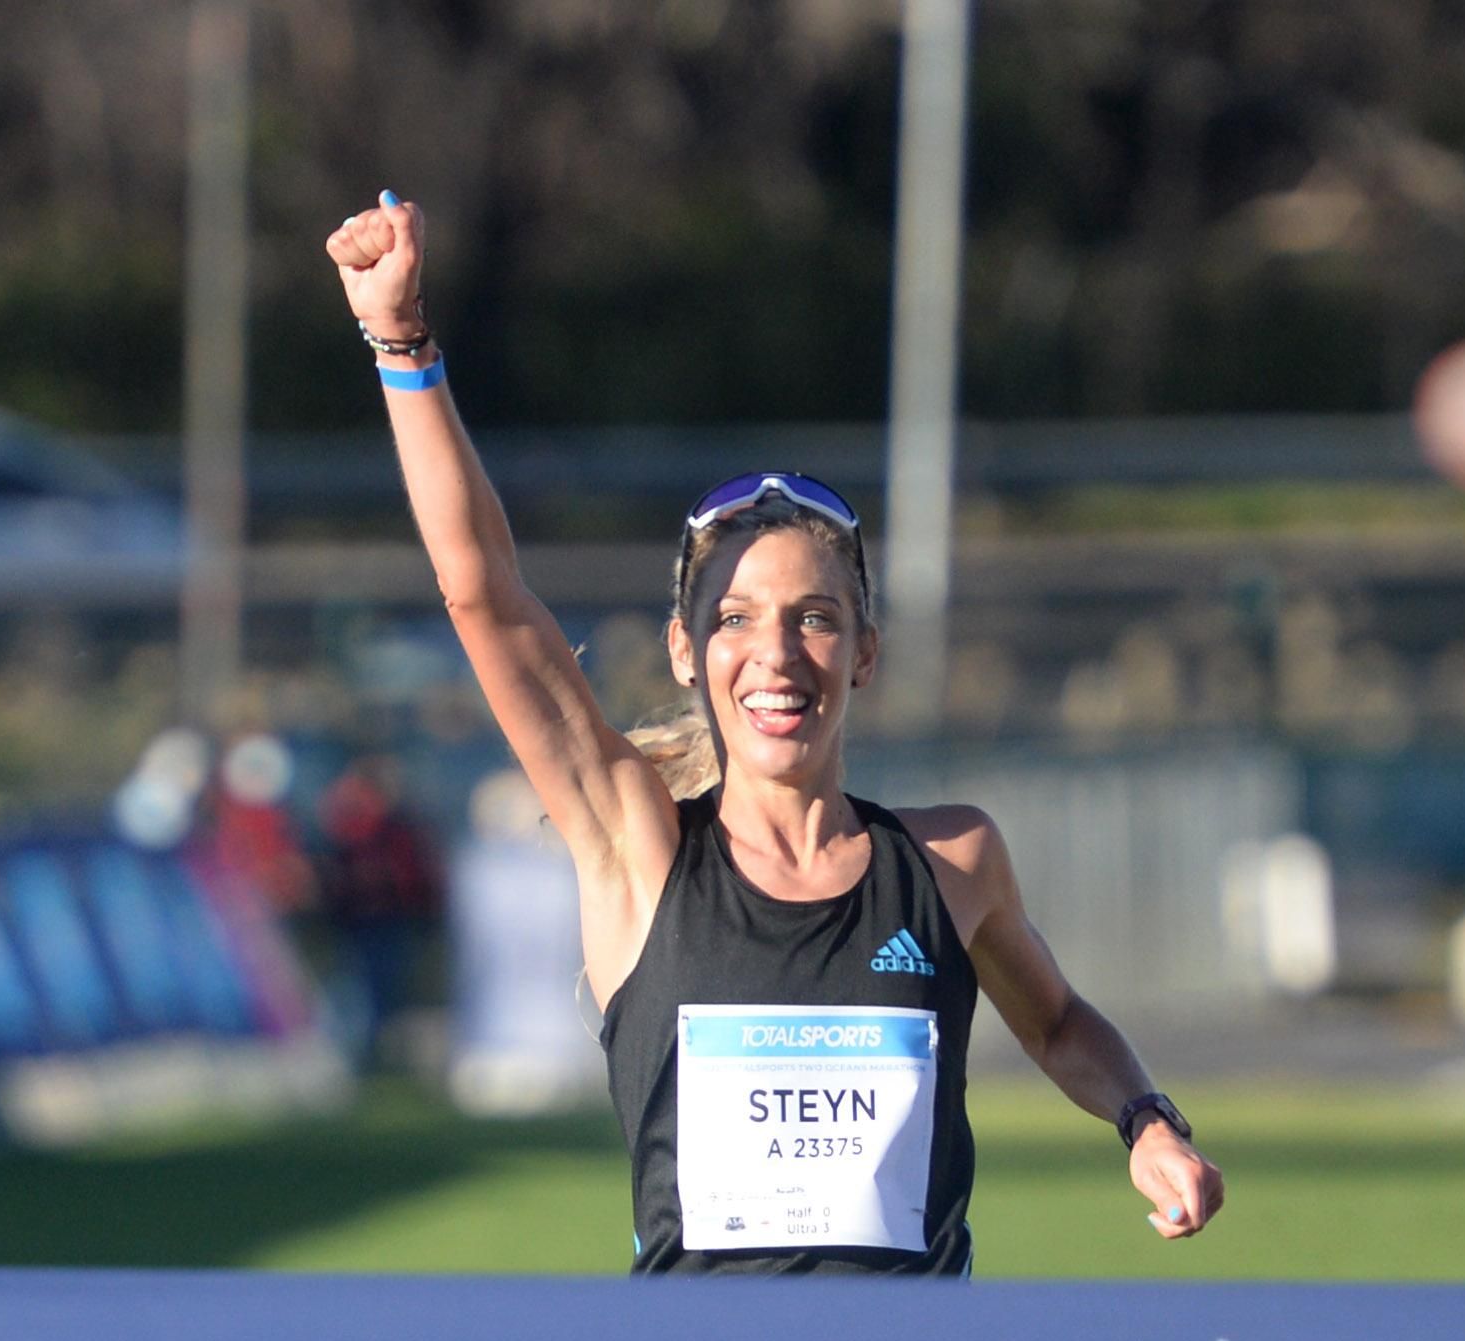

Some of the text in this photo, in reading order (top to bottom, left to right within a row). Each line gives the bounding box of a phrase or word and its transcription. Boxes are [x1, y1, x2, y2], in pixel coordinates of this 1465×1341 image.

[870, 954, 935, 976] adidas
[741, 1025, 882, 1048] TOTALSPORTS
[749, 1089, 876, 1123] STEYN
[767, 1136, 863, 1159] A 23375
[787, 1207, 811, 1218] Half
[787, 1223, 817, 1234] Ultra
